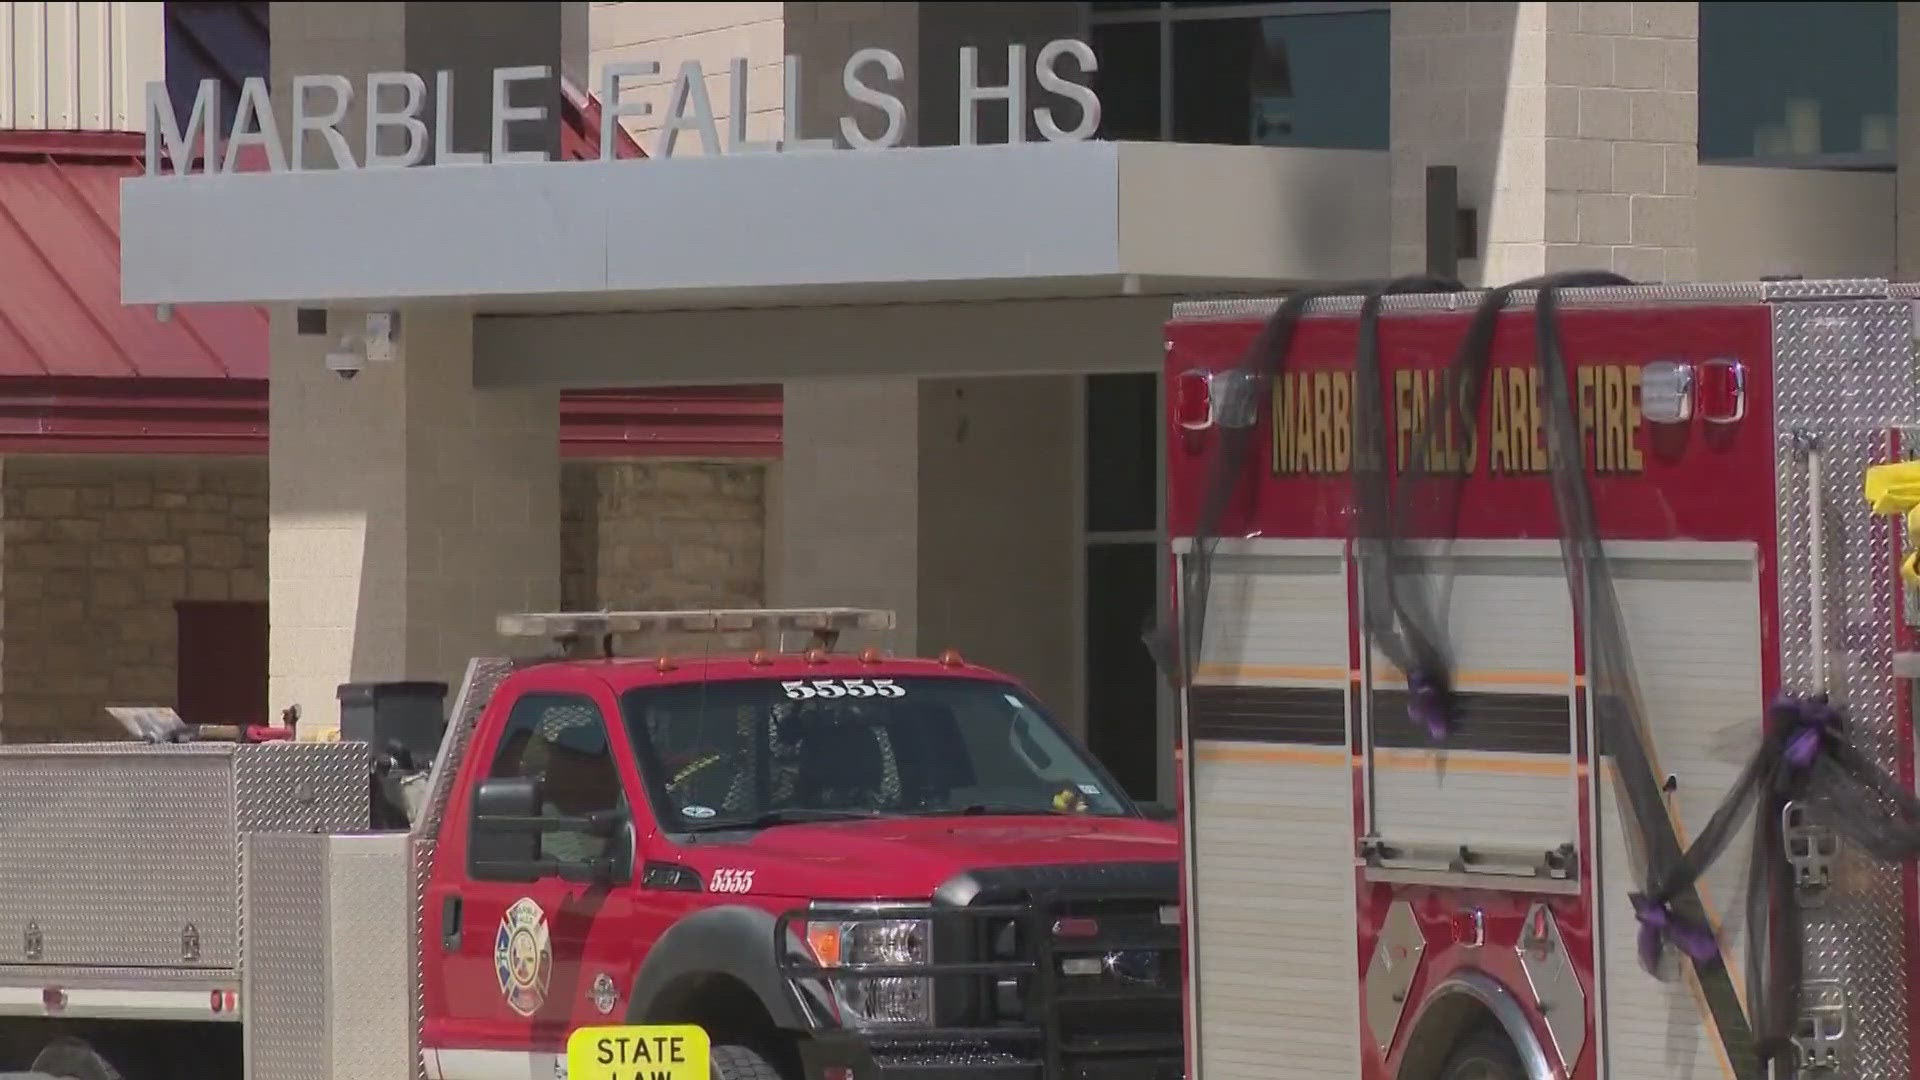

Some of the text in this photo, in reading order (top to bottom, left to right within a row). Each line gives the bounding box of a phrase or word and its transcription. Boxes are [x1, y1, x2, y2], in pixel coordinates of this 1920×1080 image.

[144, 38, 1102, 176] MARBLE FALLS HS
[1272, 369, 1381, 473] MARB
[1491, 367, 1566, 471] ARE
[1578, 365, 1643, 471] FIRE
[781, 679, 906, 699] 5555
[709, 868, 756, 894] 5555
[597, 1037, 685, 1064] STATE
